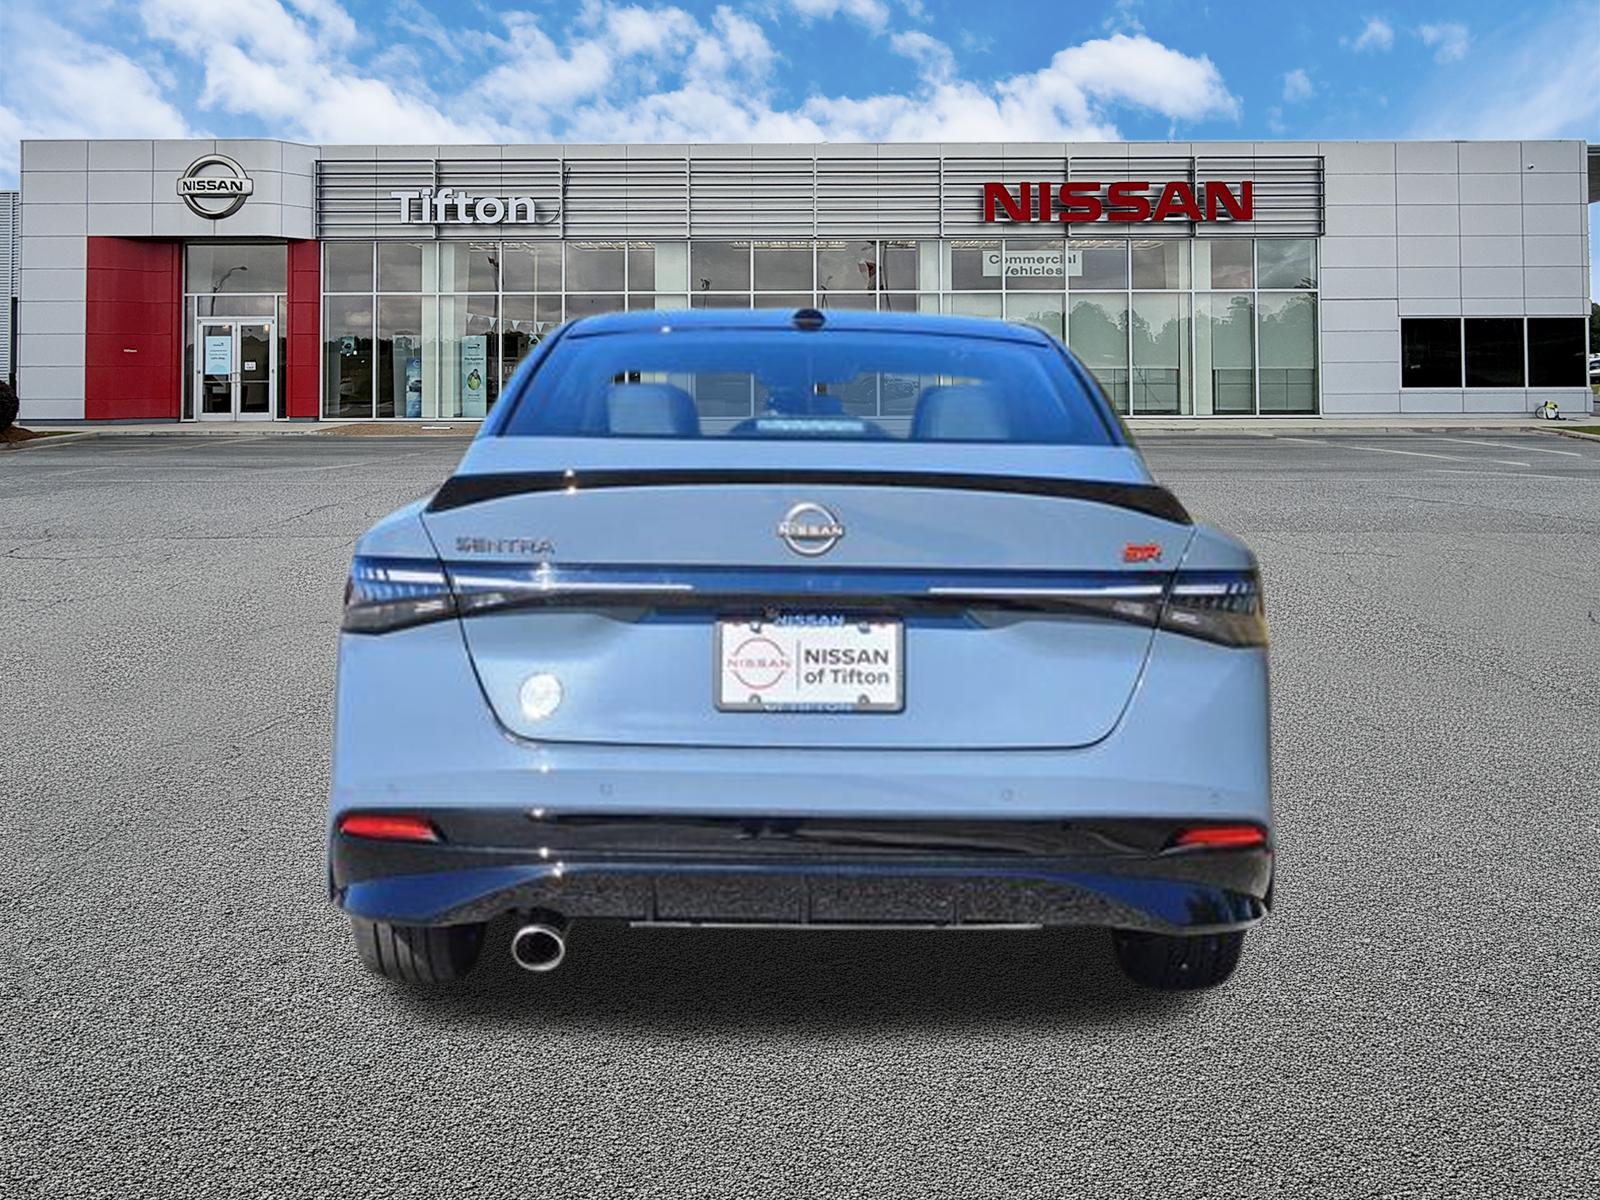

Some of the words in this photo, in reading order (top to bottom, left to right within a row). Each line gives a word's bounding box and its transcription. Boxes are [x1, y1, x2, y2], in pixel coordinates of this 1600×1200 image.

[183, 181, 243, 191] NISSAN
[391, 188, 536, 224] Tifton
[983, 181, 1253, 222] NISSAN
[778, 522, 845, 537] NISSAN
[456, 537, 556, 555] SENTRA
[1123, 543, 1162, 564] SR
[727, 658, 790, 668] NISSAN
[803, 649, 889, 665] NISSAN
[804, 669, 825, 684] of
[831, 669, 889, 684] Tifton
